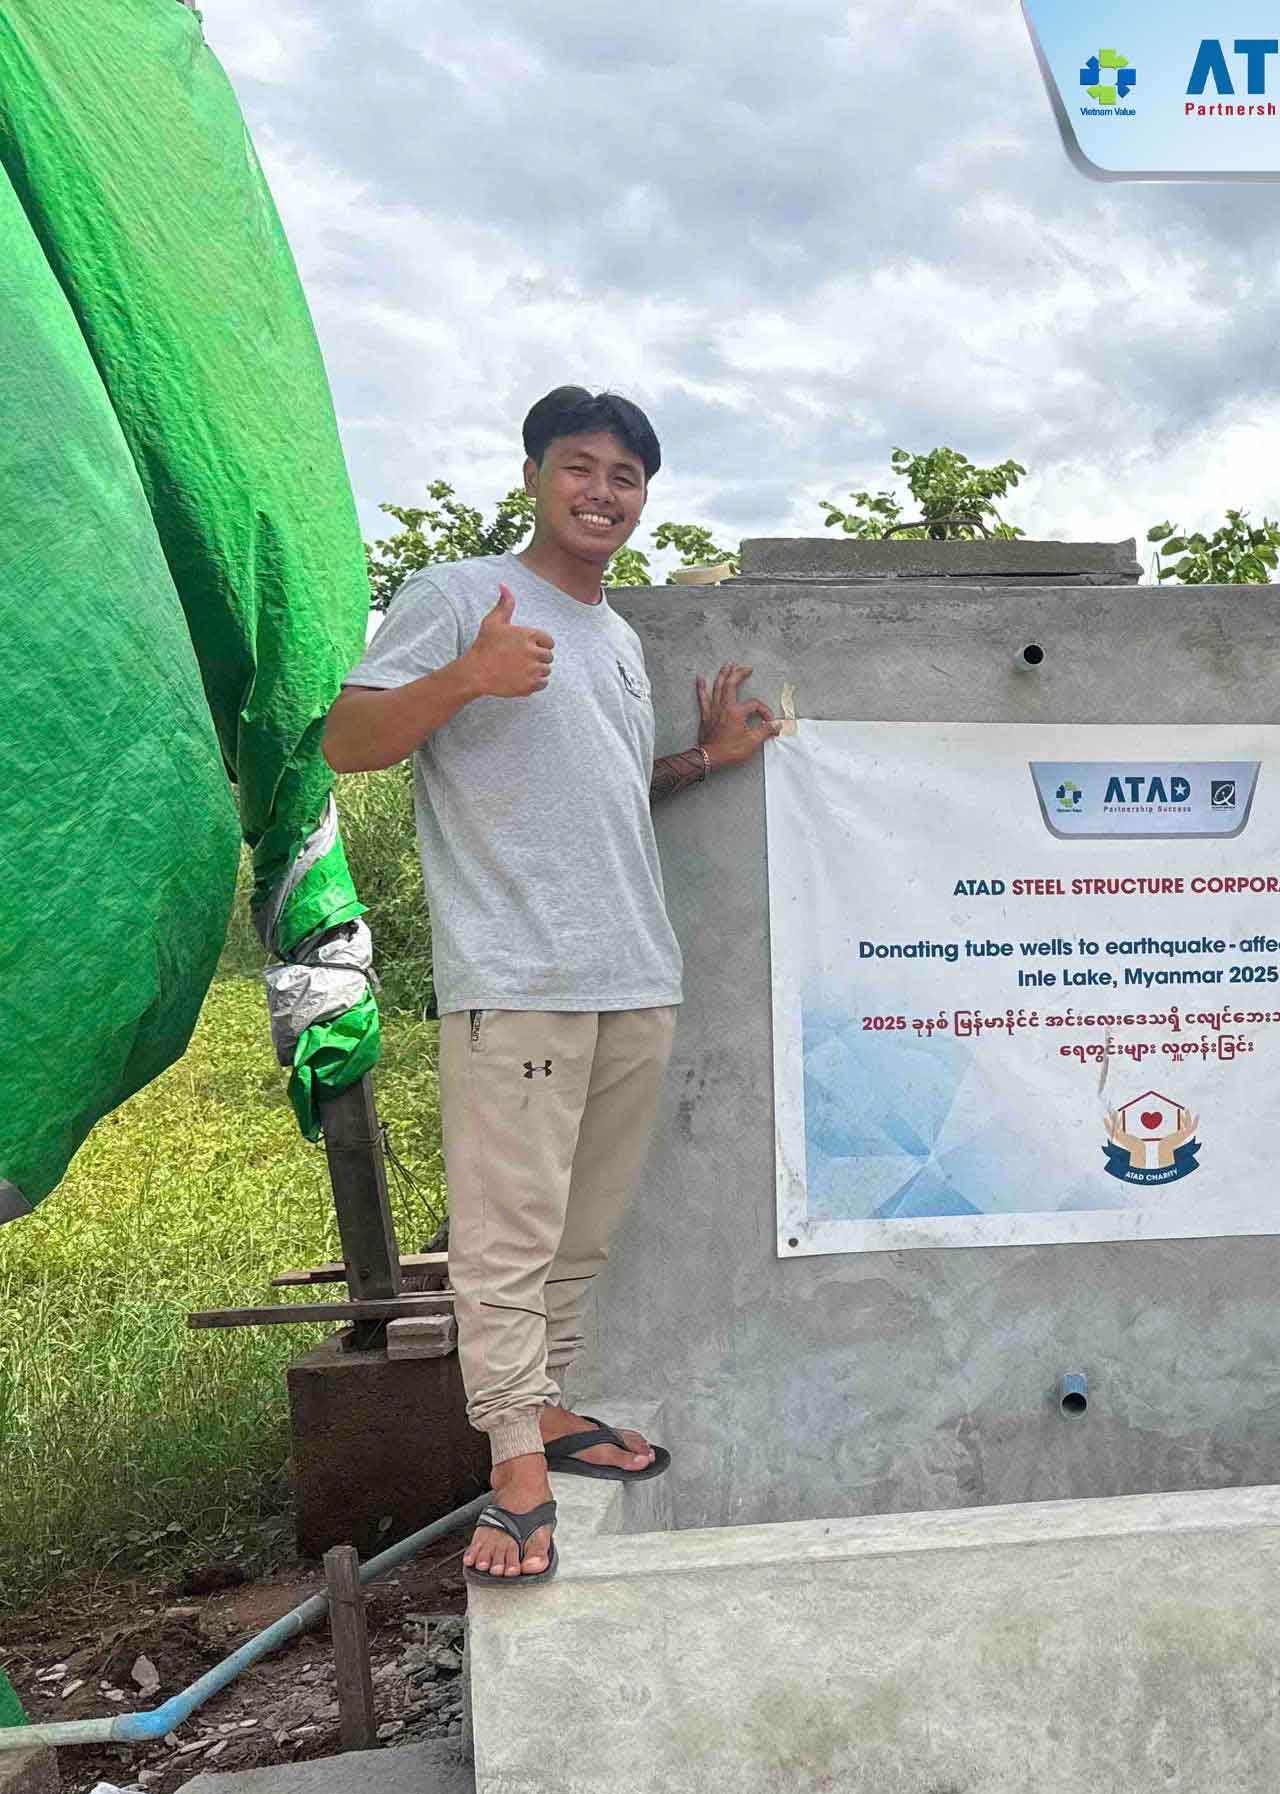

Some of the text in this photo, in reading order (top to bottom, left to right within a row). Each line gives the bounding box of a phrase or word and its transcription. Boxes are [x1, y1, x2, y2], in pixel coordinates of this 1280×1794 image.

[1103, 776, 1191, 803] ATAD
[1103, 805, 1192, 814] Partnership Success
[953, 879, 1006, 896] ATAD
[1012, 879, 1066, 896] STEEL
[1071, 877, 1185, 895] STRUCTURE
[859, 940, 959, 962] Donating
[964, 939, 1014, 957] tube
[1019, 938, 1073, 956] wells
[1077, 938, 1100, 956] to
[1018, 965, 1279, 989] Inle Lake, Myanmar 2025
[862, 1015, 907, 1031] 2025
[1125, 1168, 1178, 1181] ATAD CHARITY
